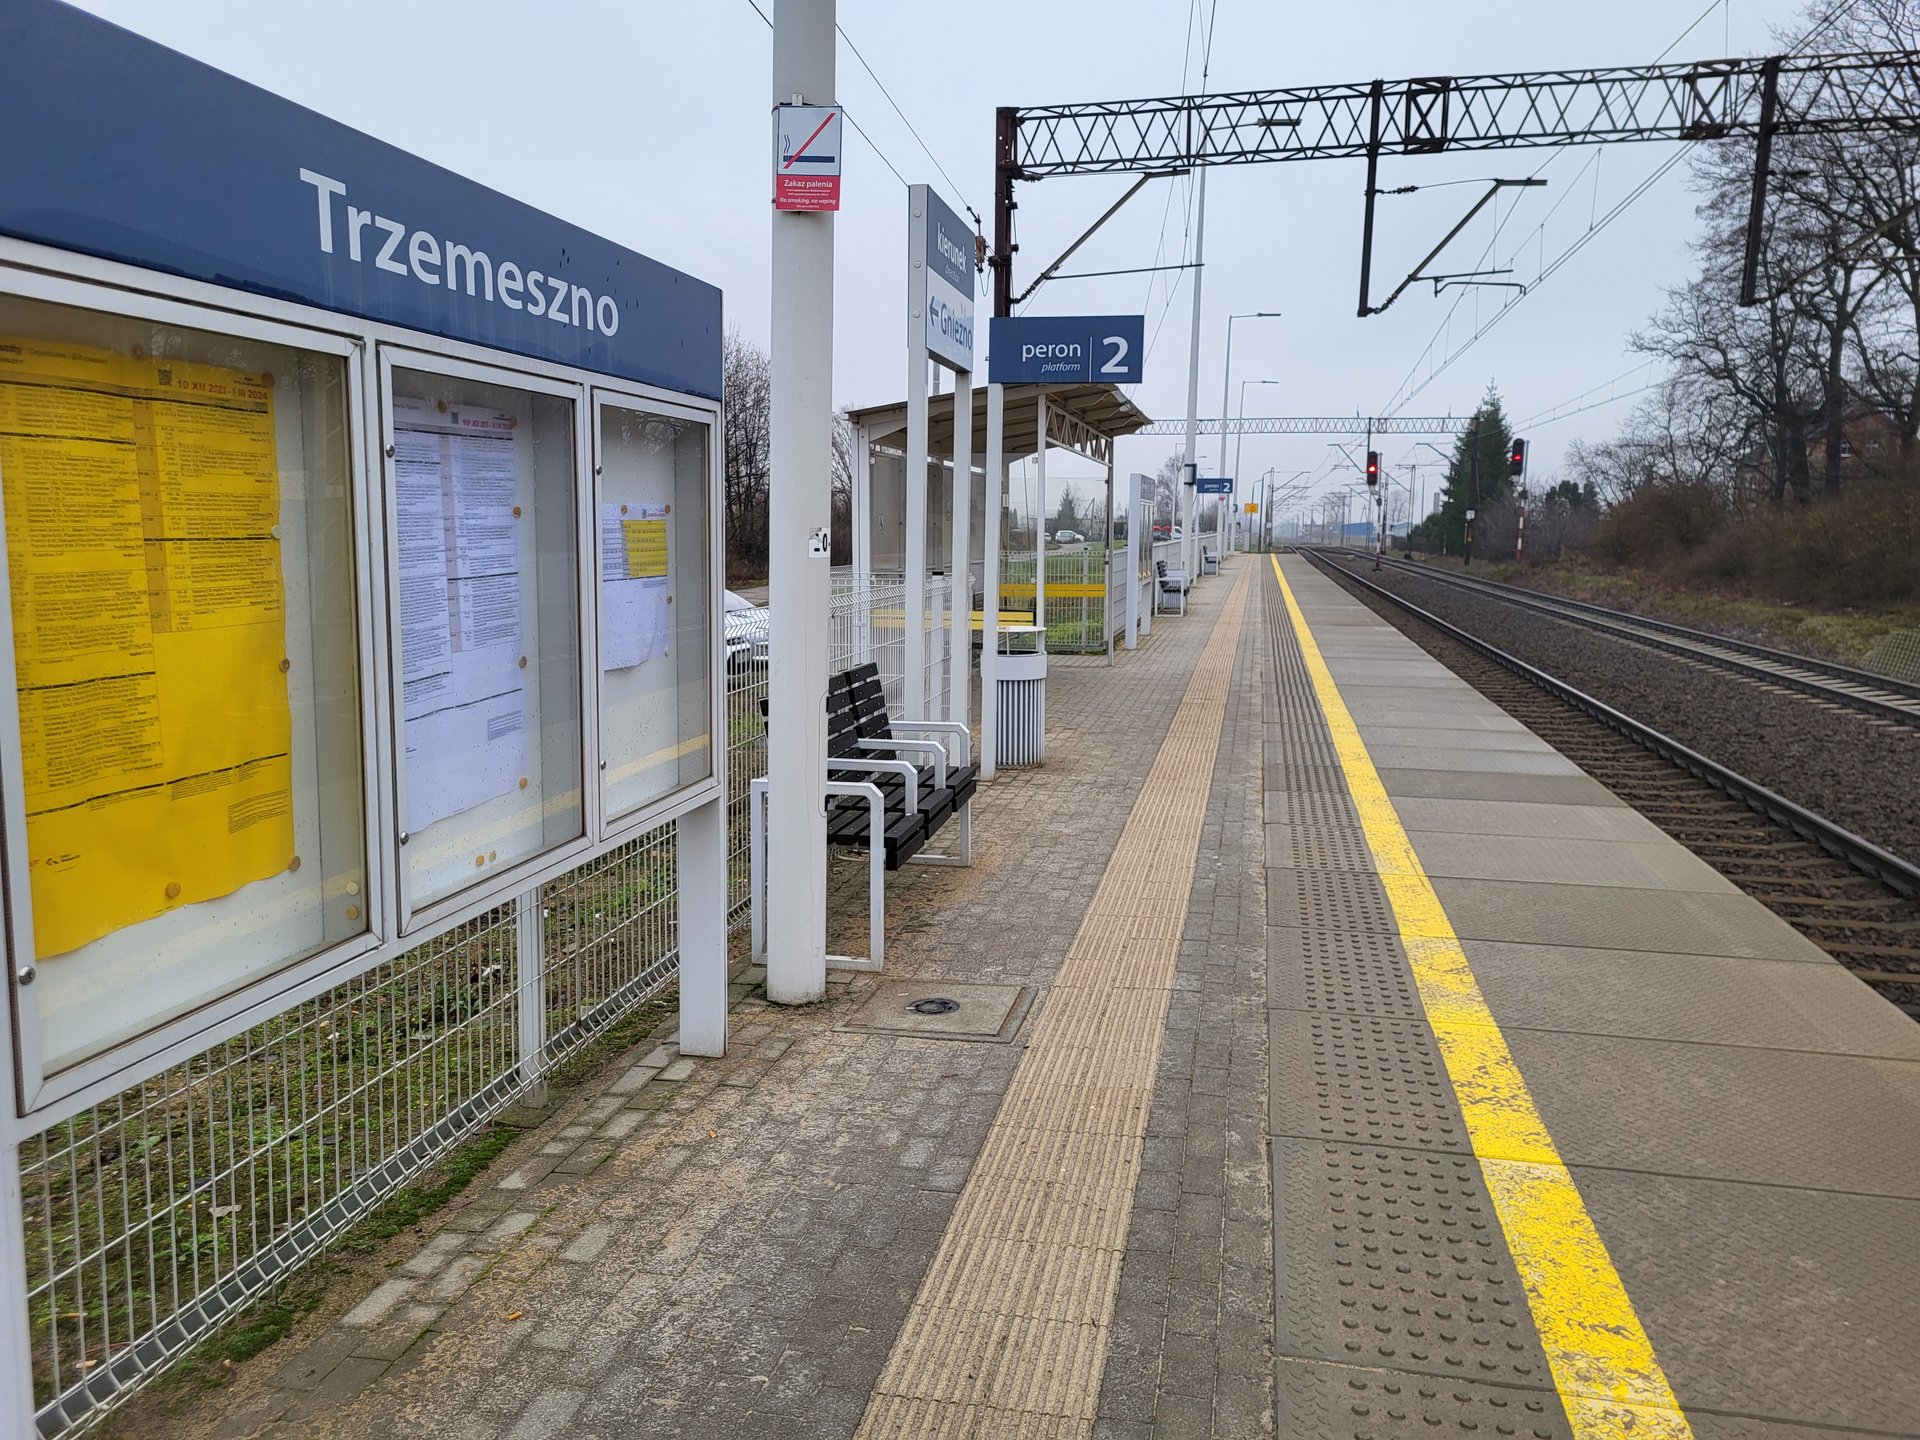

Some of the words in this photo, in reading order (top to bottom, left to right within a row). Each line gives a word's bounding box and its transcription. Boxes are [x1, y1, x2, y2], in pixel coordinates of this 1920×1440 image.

[784, 179, 805, 187] Zakaz
[806, 180, 833, 188] palenia
[300, 167, 619, 337] Trzemeszno
[937, 221, 967, 275] kierunek
[940, 302, 973, 351] Gniezno
[1022, 343, 1081, 362] peron
[1100, 336, 1129, 374] 2
[1040, 361, 1081, 374] platform
[177, 380, 189, 389] 10
[192, 381, 206, 391] XII
[247, 389, 268, 400] 2024
[1223, 482, 1231, 492] 2
